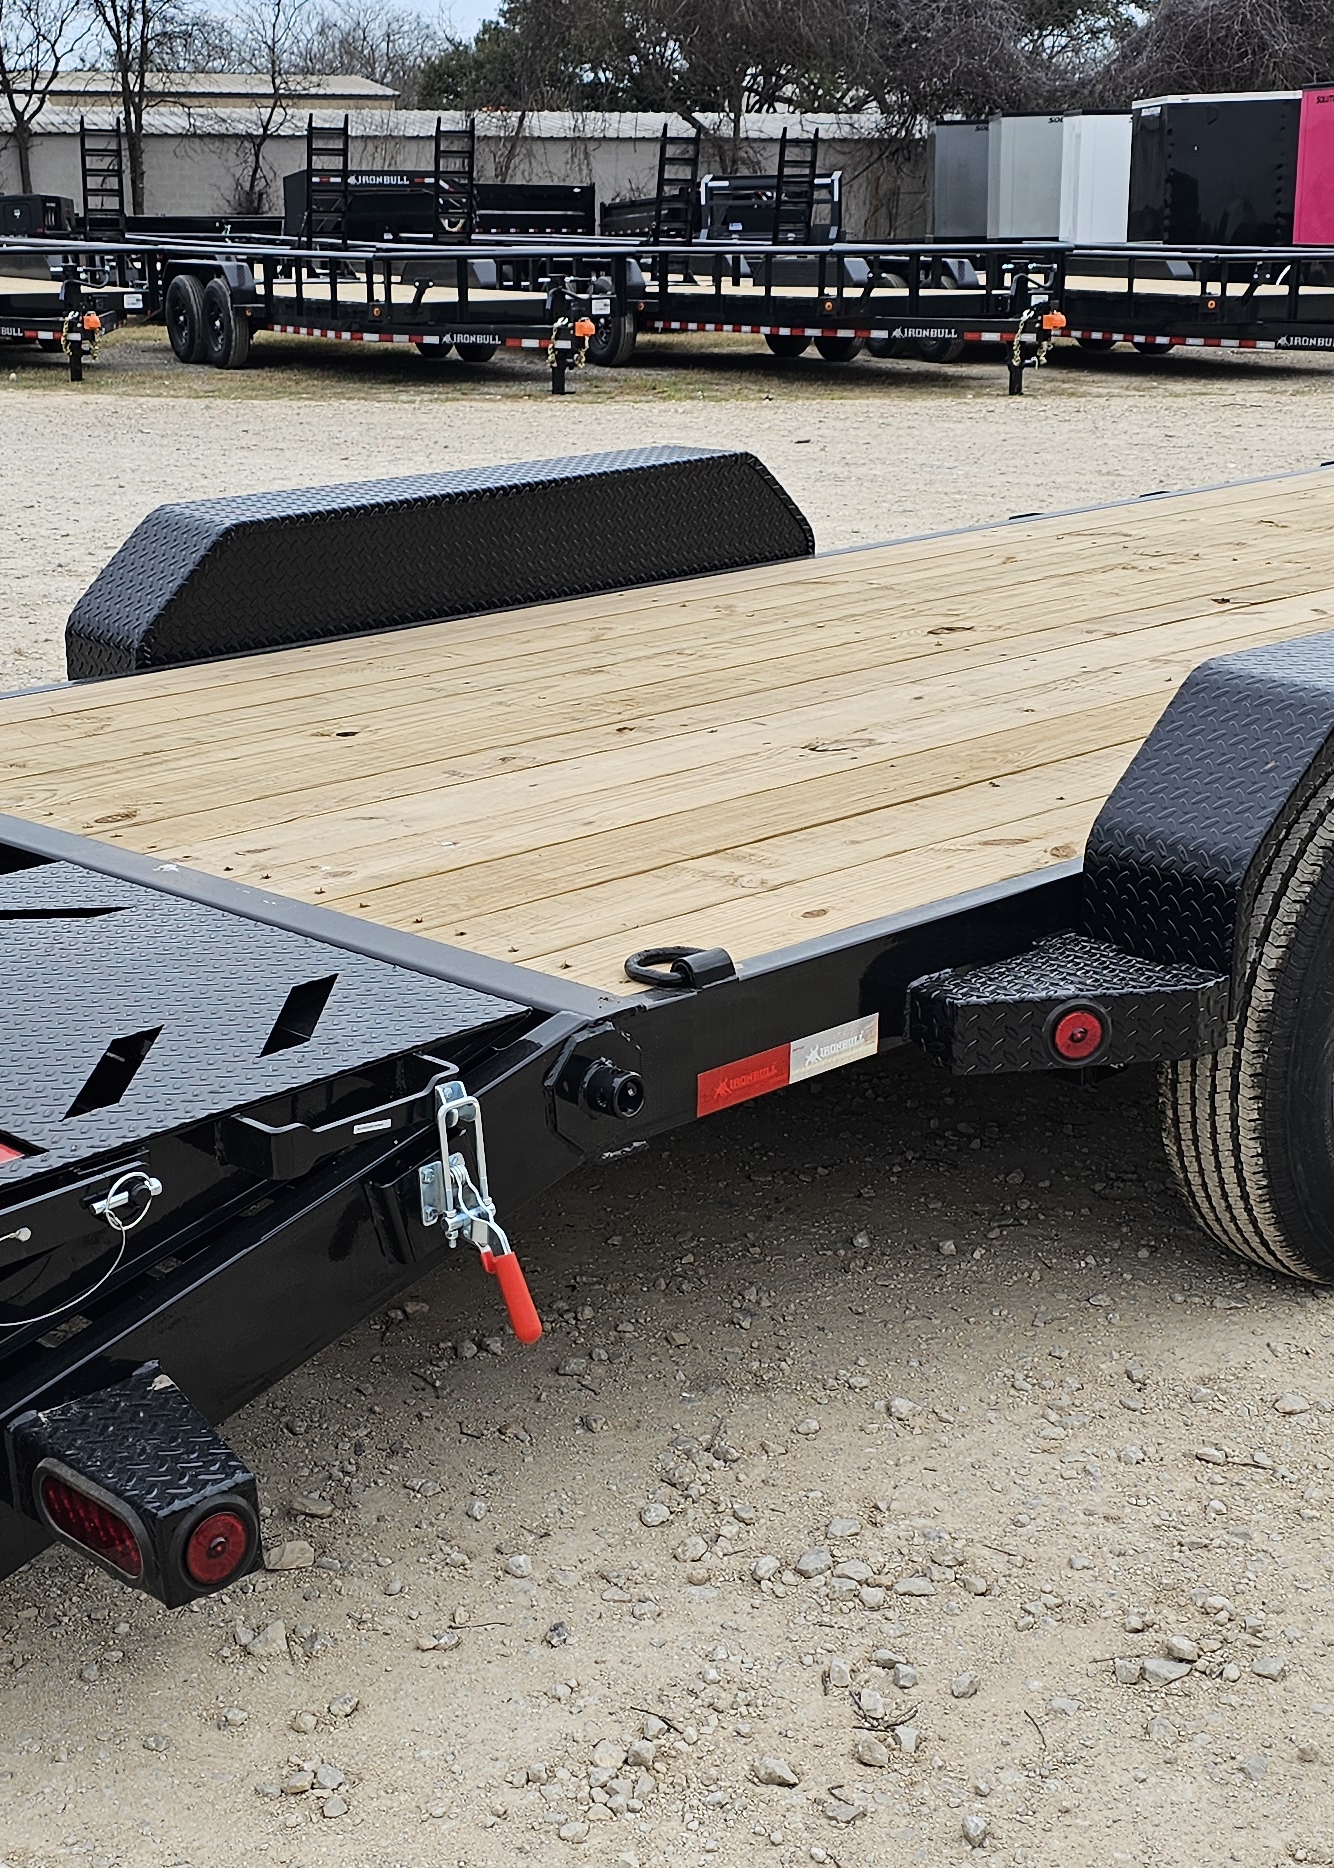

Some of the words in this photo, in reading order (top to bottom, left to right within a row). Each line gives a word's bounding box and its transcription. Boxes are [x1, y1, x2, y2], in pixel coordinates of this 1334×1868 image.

[358, 175, 410, 185] IRONBULL
[453, 333, 502, 345] IRONBULL
[904, 328, 958, 339] IRONBULL
[820, 1031, 864, 1058] IRONBULL
[729, 1064, 777, 1090] IRONBULL
